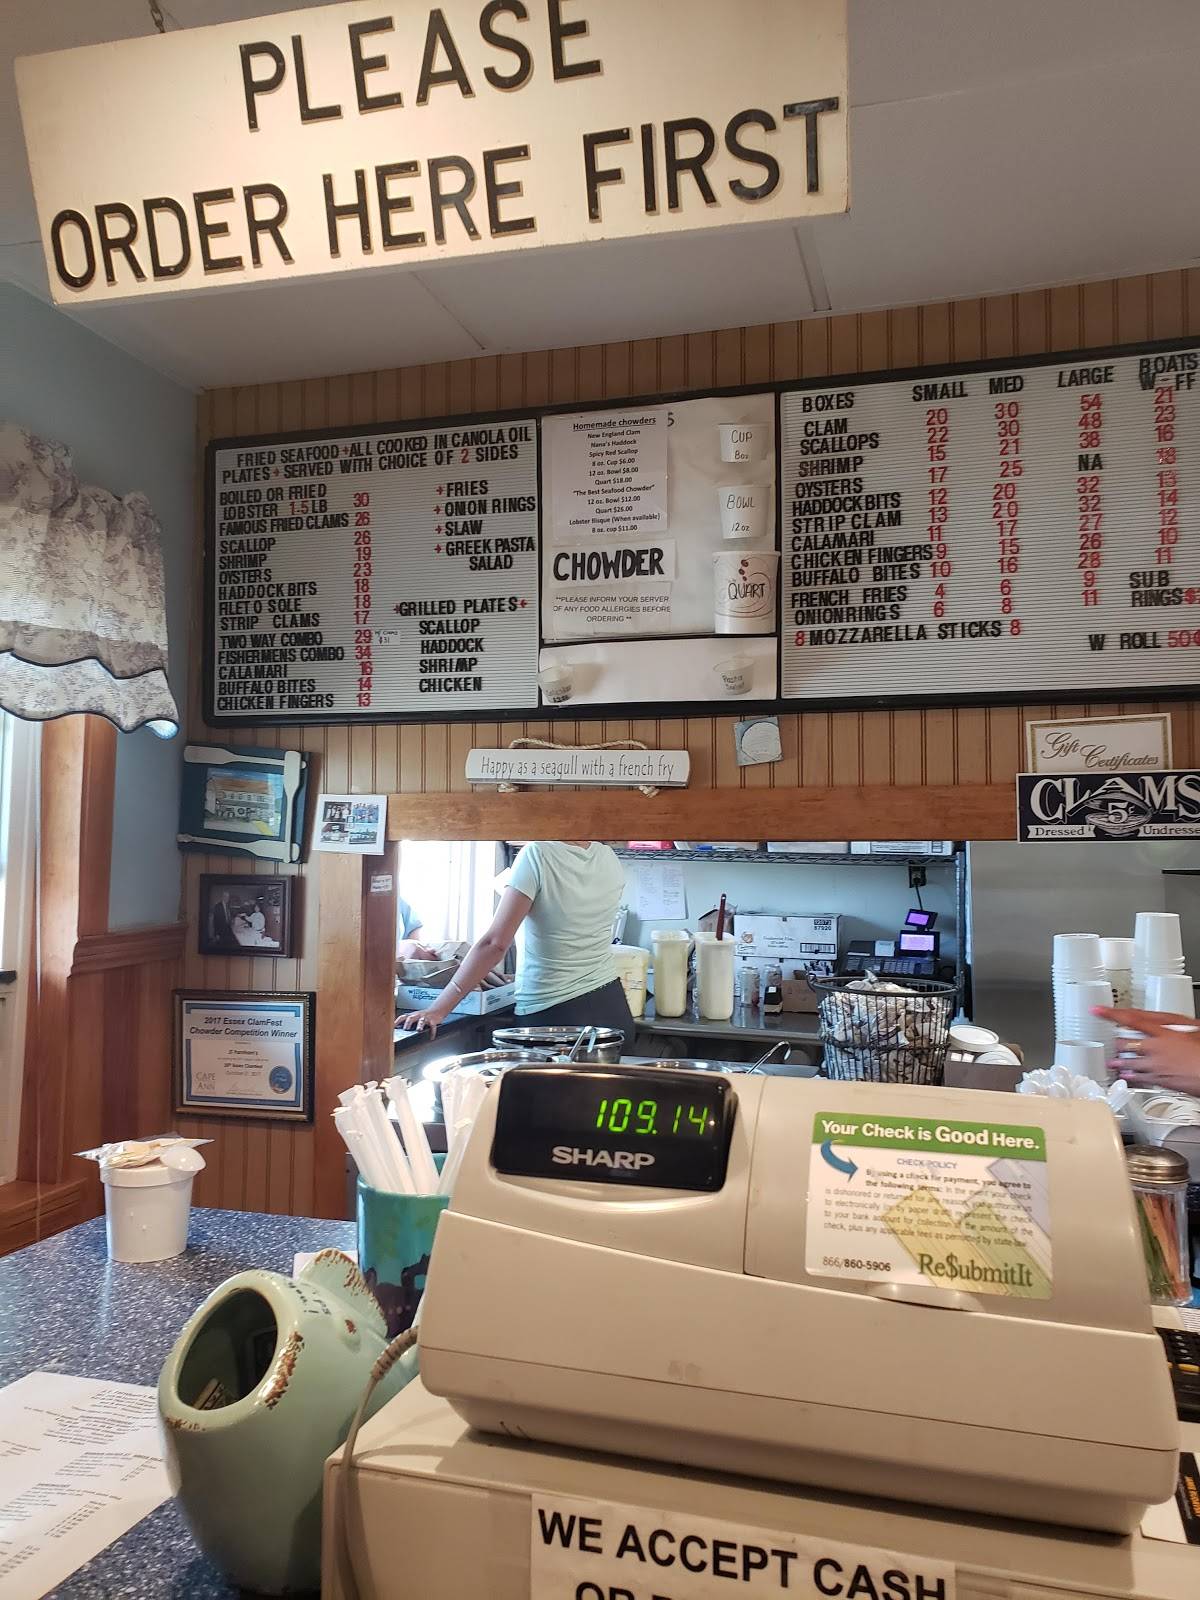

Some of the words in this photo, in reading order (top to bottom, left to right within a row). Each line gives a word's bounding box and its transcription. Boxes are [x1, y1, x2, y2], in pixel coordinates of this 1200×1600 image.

[240, 0, 600, 132] PLEASE
[50, 183, 296, 289] ORDER
[322, 143, 536, 258] HERE
[584, 96, 840, 220] FIRST
[802, 392, 854, 413] BOXES
[912, 380, 968, 401] SMALL
[989, 376, 1024, 394] MED
[1057, 366, 1115, 387] LARGE
[1140, 353, 1199, 373] BOATS
[573, 419, 616, 430] Homemade
[619, 417, 656, 426] chowders
[804, 418, 848, 437] CLAM
[927, 408, 948, 425] 20
[731, 430, 752, 443] CUP
[801, 432, 879, 455] SCALLOPS
[928, 427, 948, 444] 22
[237, 452, 276, 467] FRIED
[281, 444, 339, 463] SEAFOOD
[350, 442, 372, 457] ALL
[377, 436, 427, 454] COOKED
[434, 434, 447, 449] IN
[452, 429, 504, 447] CANOLA
[509, 427, 531, 442] OIL
[223, 466, 270, 484] PLATES
[284, 461, 333, 479] SERVED
[340, 458, 372, 474] WITH
[379, 453, 426, 470] CHOICE
[435, 450, 453, 466] OF
[461, 449, 469, 463] 2
[476, 444, 518, 462] SIDES
[799, 456, 864, 477] SHRIMP
[928, 445, 946, 461] 15
[446, 480, 488, 497] FRIES
[795, 477, 863, 498] OYSTERS
[928, 467, 948, 483] 17
[220, 489, 261, 506] BOILED
[267, 487, 284, 501] OR
[289, 484, 327, 499] FRIED
[727, 494, 756, 510] BOWL
[792, 495, 862, 517] HADDOCK
[865, 492, 901, 510] BITS
[929, 488, 947, 505] 12
[224, 504, 277, 520] LOBSTER
[312, 500, 327, 513] LB
[444, 500, 487, 516] ONION
[492, 496, 536, 514] RINGS
[219, 519, 267, 536] FAMOUS
[270, 517, 303, 532] FRIED
[306, 513, 348, 529] CLAMS
[445, 520, 483, 536] SLAW
[793, 514, 845, 534] STRIP
[851, 511, 901, 529] CLAM
[928, 507, 947, 523] 13
[220, 537, 276, 554] SCALLOP
[446, 539, 492, 556] GREEK
[495, 537, 535, 553] PASTA
[791, 530, 874, 551] CALAMARI
[219, 553, 267, 570] SHRIMP
[470, 555, 513, 570] SALAD
[553, 548, 664, 581] CHOWDER
[791, 549, 862, 570] CHICKEN
[868, 544, 933, 564] FINGERS
[936, 543, 946, 559] 9
[219, 569, 271, 584] OYSTERS
[792, 567, 859, 587] BUFFALO
[873, 563, 920, 582] BITES
[930, 561, 951, 578] 10
[1130, 570, 1169, 588] SUB
[219, 583, 284, 600] HADDOCK
[288, 582, 317, 596] BITS
[728, 582, 765, 600] QUART
[792, 590, 849, 608] FRENCH
[863, 585, 907, 603] FRIES
[1132, 588, 1183, 607] RINGS
[400, 600, 456, 616] GRILLED
[464, 597, 518, 613] PLATES
[795, 607, 843, 625] ONION
[846, 604, 900, 622] RINGS
[220, 616, 258, 631] STRIP
[273, 613, 320, 628] CLAMS
[419, 618, 480, 634] SCALLOP
[220, 635, 247, 649] TWO
[251, 634, 276, 648] WAY
[281, 632, 322, 646] COMBO
[795, 631, 805, 646] 8
[810, 625, 927, 646] MOZZARELLA
[938, 620, 1001, 639] STICKS
[1010, 619, 1021, 636] 8
[1120, 632, 1161, 649] ROLL
[218, 650, 296, 664] FISHERMENS
[301, 647, 344, 662] COMBO
[421, 638, 484, 654] HADDOCK
[219, 664, 288, 679] CALAMARI
[419, 657, 478, 673] SHRIMP
[219, 680, 273, 695] BUFFALO
[277, 679, 316, 693] BITES
[419, 677, 482, 692] CHICKEN
[218, 695, 273, 710] CHICKEN
[280, 694, 334, 709] FINGERS
[1040, 732, 1080, 759] Gift
[1080, 744, 1159, 770] Certificates
[481, 756, 514, 779] Happy
[517, 762, 528, 774] as
[531, 763, 536, 774] a
[541, 755, 577, 778] seagull
[582, 757, 605, 775] with
[609, 763, 614, 775] a
[619, 754, 653, 776] french
[658, 755, 674, 782] fry
[1030, 775, 1200, 822] CLAMS
[1035, 827, 1085, 836] Dressed
[190, 1027, 223, 1035] Chowder
[224, 1028, 269, 1037] Competition
[271, 1030, 297, 1038] Winner
[821, 1120, 858, 1136] Your
[862, 1123, 914, 1140] Check
[918, 1126, 932, 1140] is
[935, 1126, 988, 1145] Good
[993, 1133, 1040, 1150] Here.
[552, 1146, 655, 1170] SHARP
[538, 1508, 603, 1555] WE
[616, 1524, 798, 1588] ACCEPT
[813, 1558, 946, 1600] CASH
